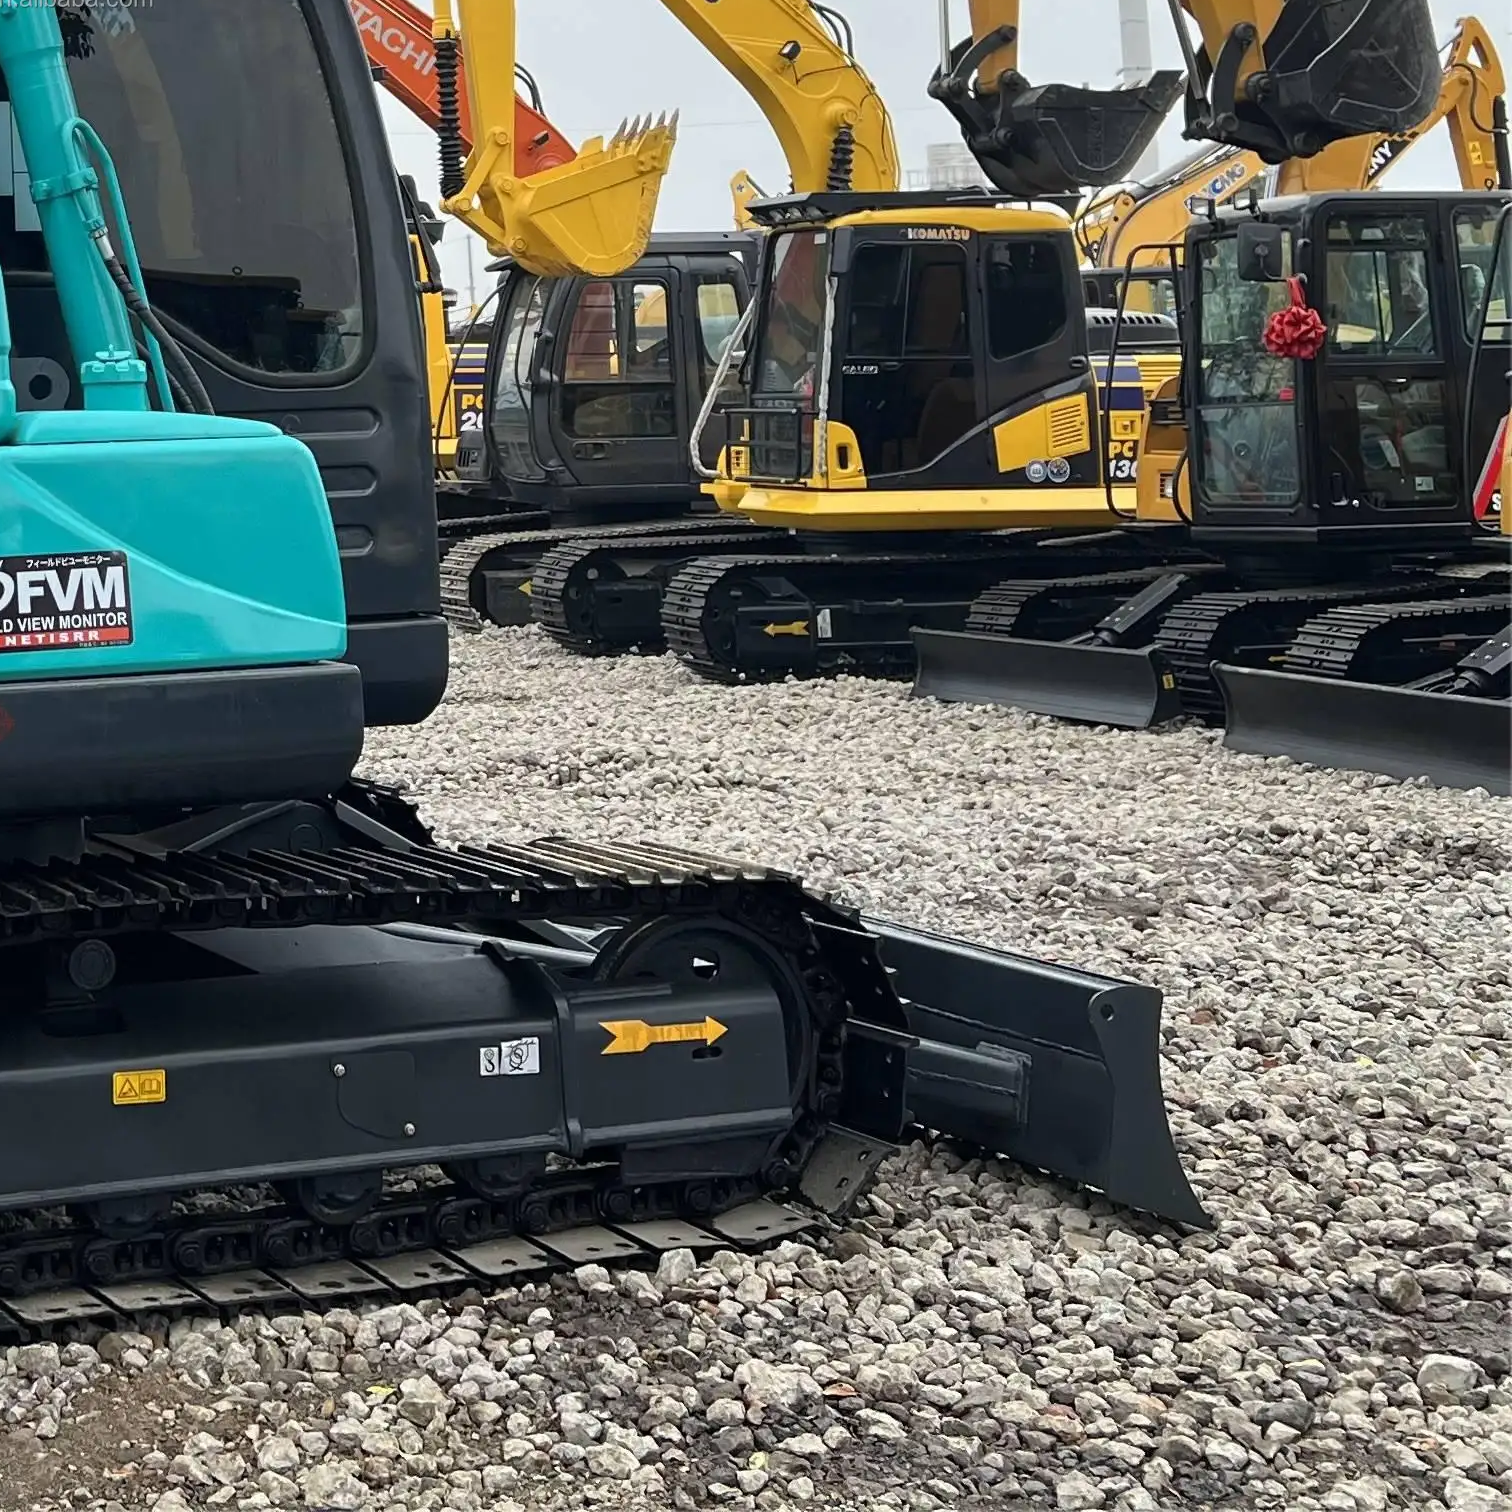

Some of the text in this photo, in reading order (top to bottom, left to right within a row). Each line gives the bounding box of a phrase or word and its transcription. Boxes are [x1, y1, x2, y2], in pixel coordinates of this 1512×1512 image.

[907, 226, 970, 241] KOMATSU
[1109, 441, 1134, 459] PC
[16, 566, 127, 615] FVM
[17, 615, 55, 632] VIEW
[59, 611, 128, 629] MONITOR
